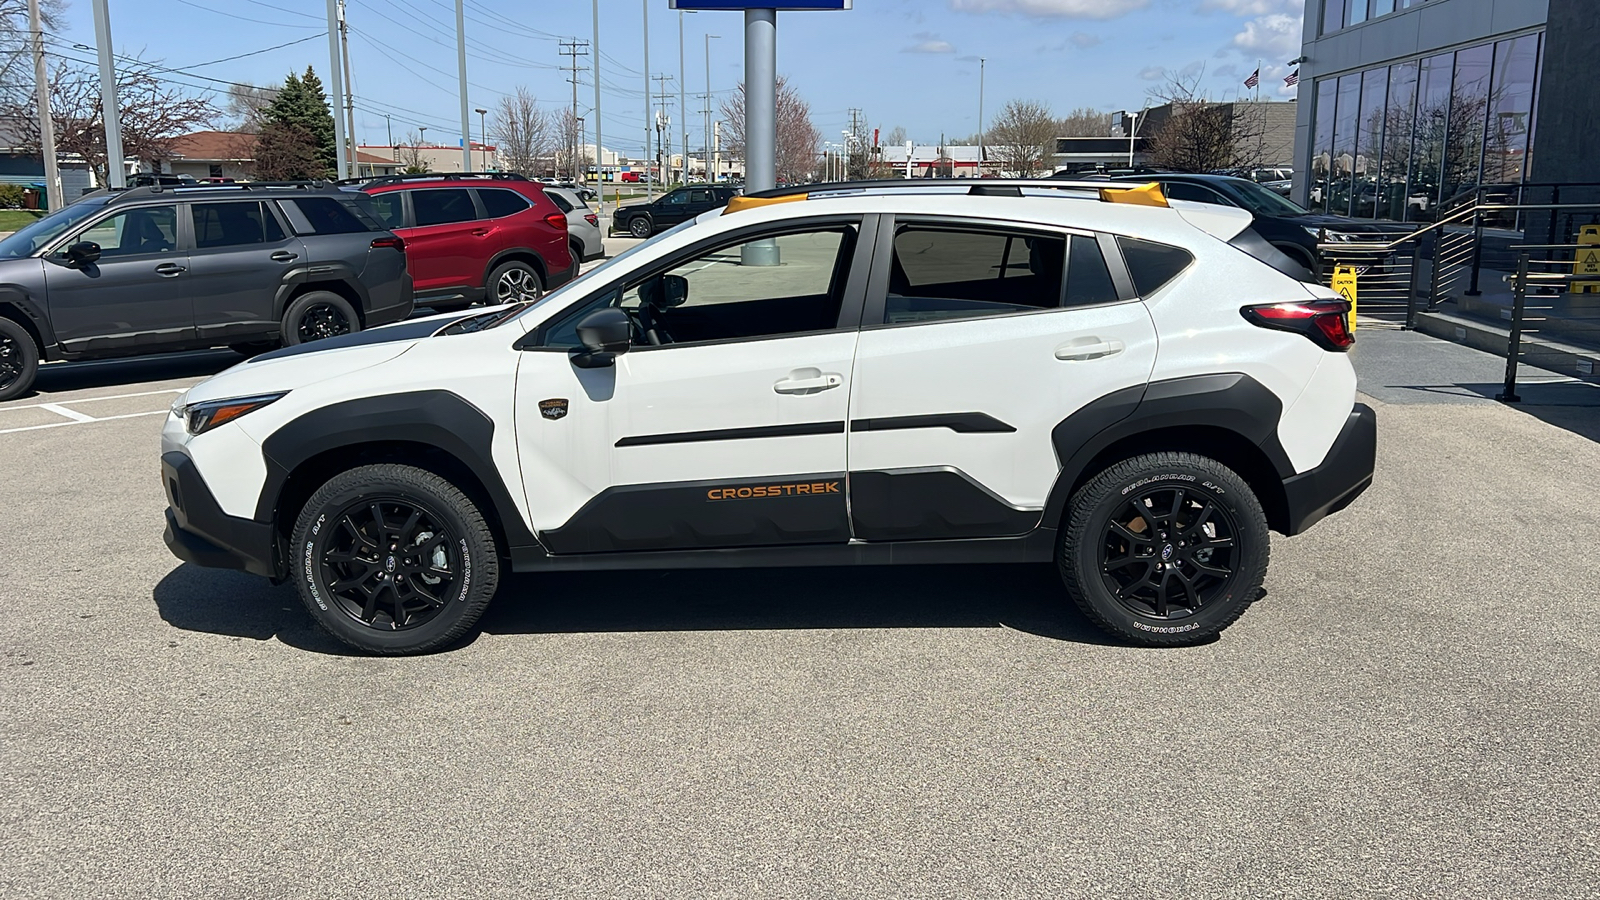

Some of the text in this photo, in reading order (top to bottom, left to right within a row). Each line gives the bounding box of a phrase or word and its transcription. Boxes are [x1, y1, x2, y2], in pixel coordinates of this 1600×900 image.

[707, 482, 839, 500] CROSSTREK
[1121, 473, 1225, 495] GEOLANDAR A/T
[305, 540, 328, 611] GEOLANDAR
[458, 538, 471, 602] YOKOHAMA
[1133, 621, 1200, 634] YOKOHAMA
